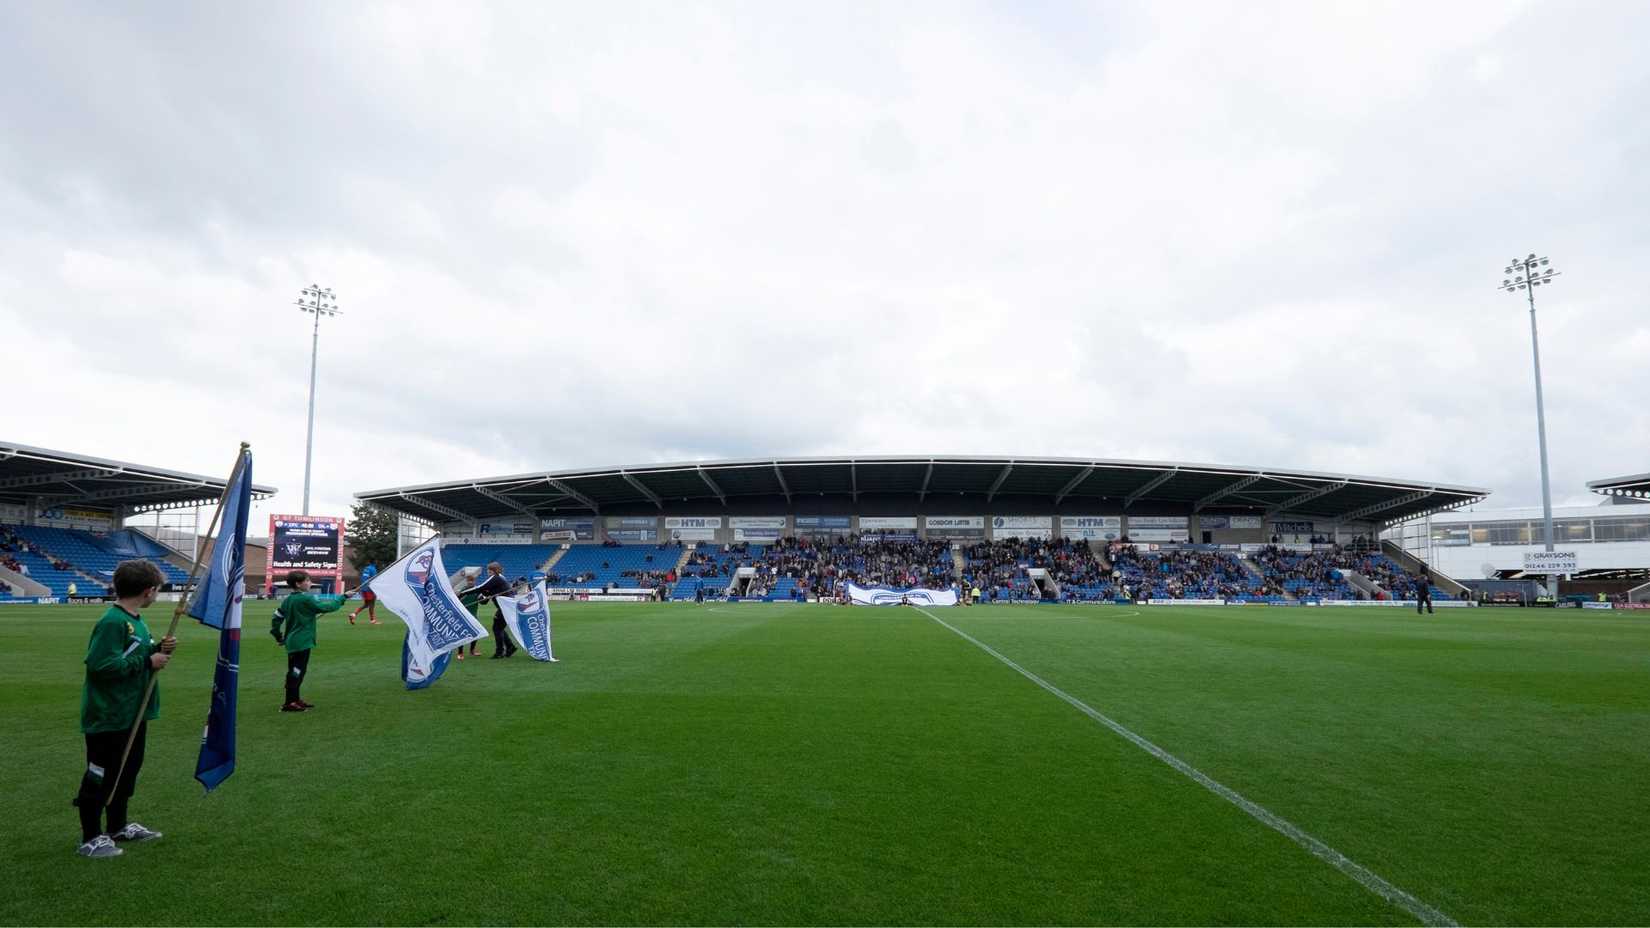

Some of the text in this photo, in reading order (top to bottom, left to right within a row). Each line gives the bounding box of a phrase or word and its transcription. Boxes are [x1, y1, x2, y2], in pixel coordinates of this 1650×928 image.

[542, 519, 566, 528] NAPIT
[681, 518, 705, 527] HTM
[1077, 518, 1104, 527] HTM
